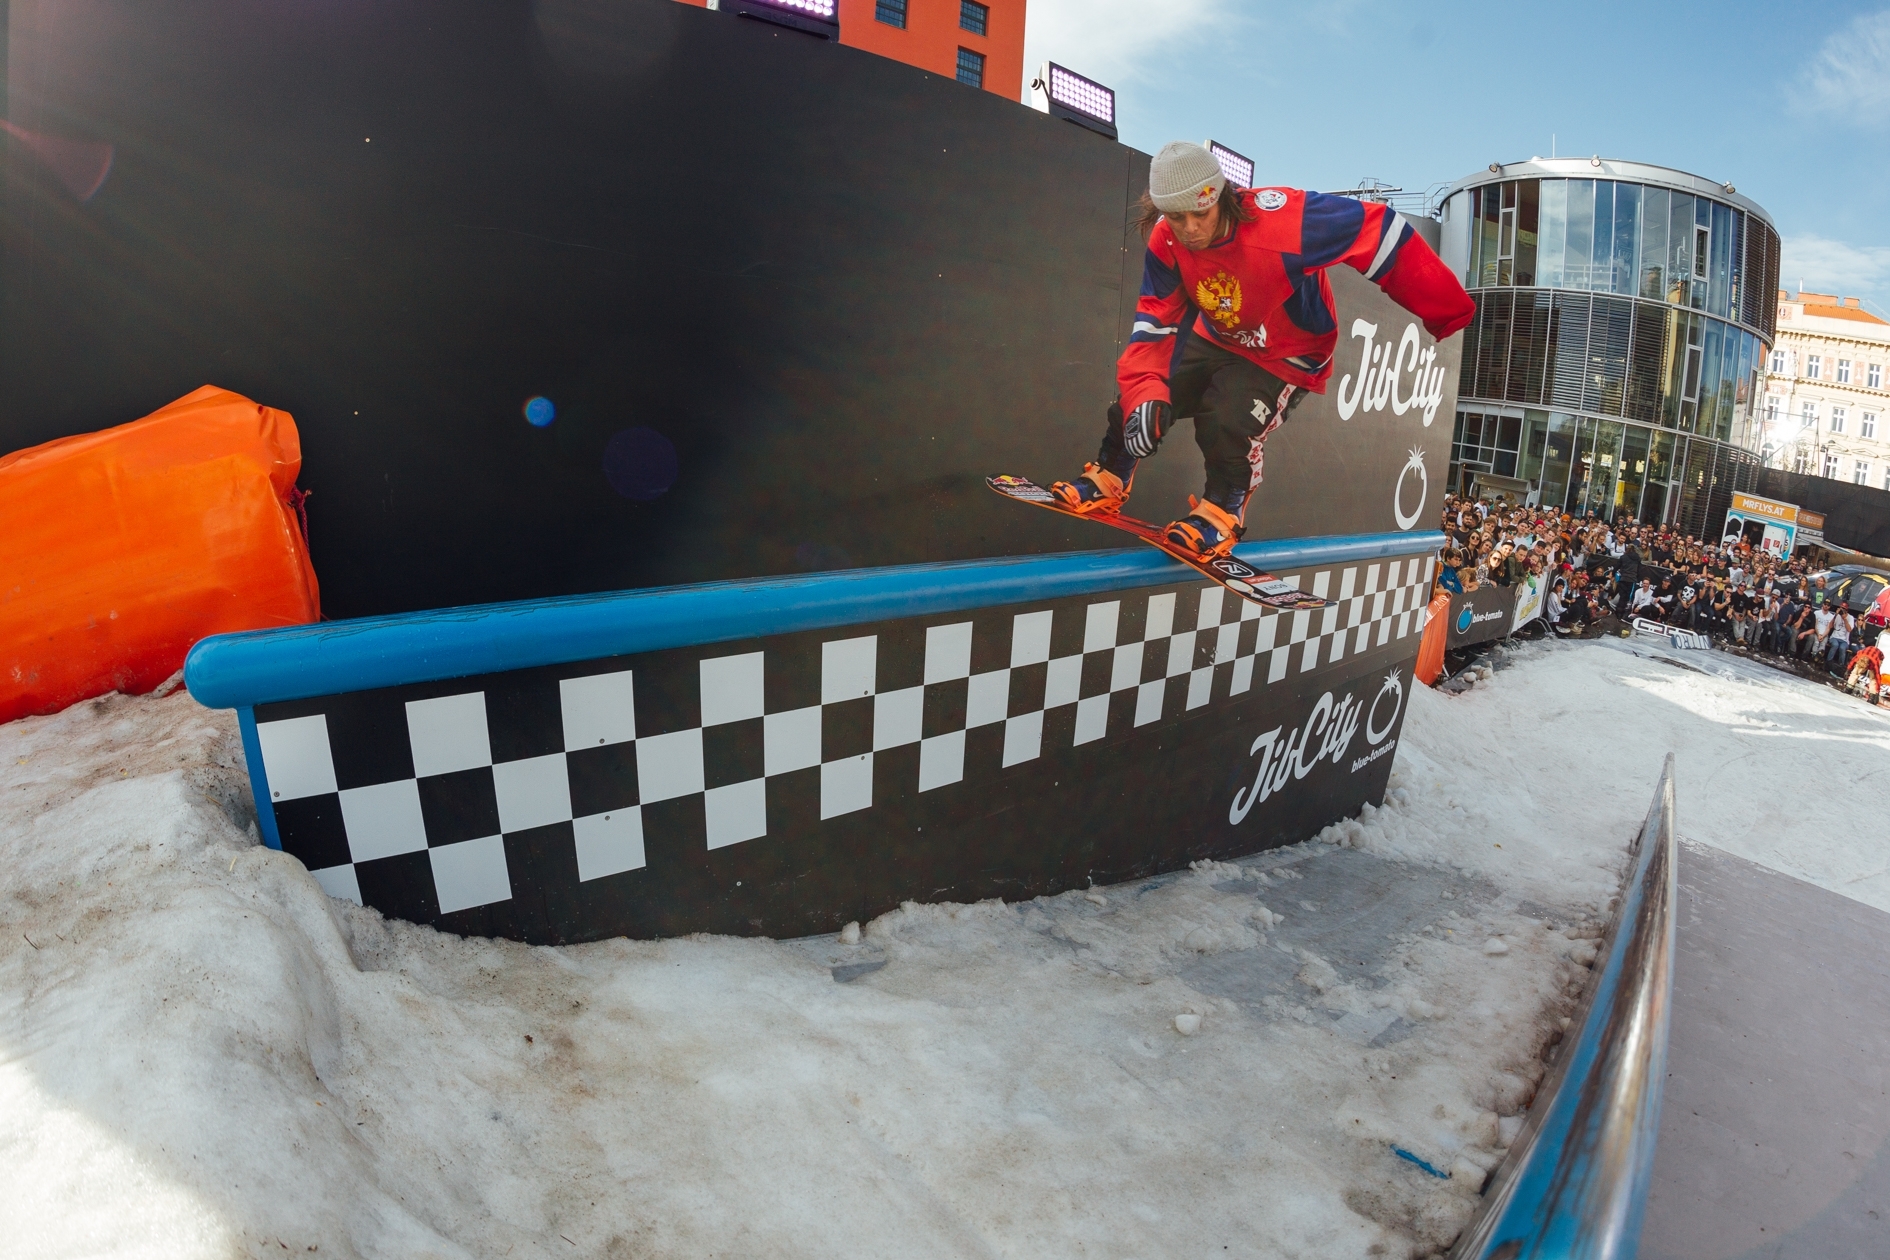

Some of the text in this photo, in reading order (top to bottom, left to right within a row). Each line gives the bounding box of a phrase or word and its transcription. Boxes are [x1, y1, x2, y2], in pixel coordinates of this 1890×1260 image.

[1337, 318, 1445, 427] JibCity
[1742, 498, 1785, 516] MRFLYS.AT
[1472, 609, 1503, 624] blue-tomato
[1228, 691, 1364, 826] JibCity
[1350, 739, 1396, 774] blue-tomato
